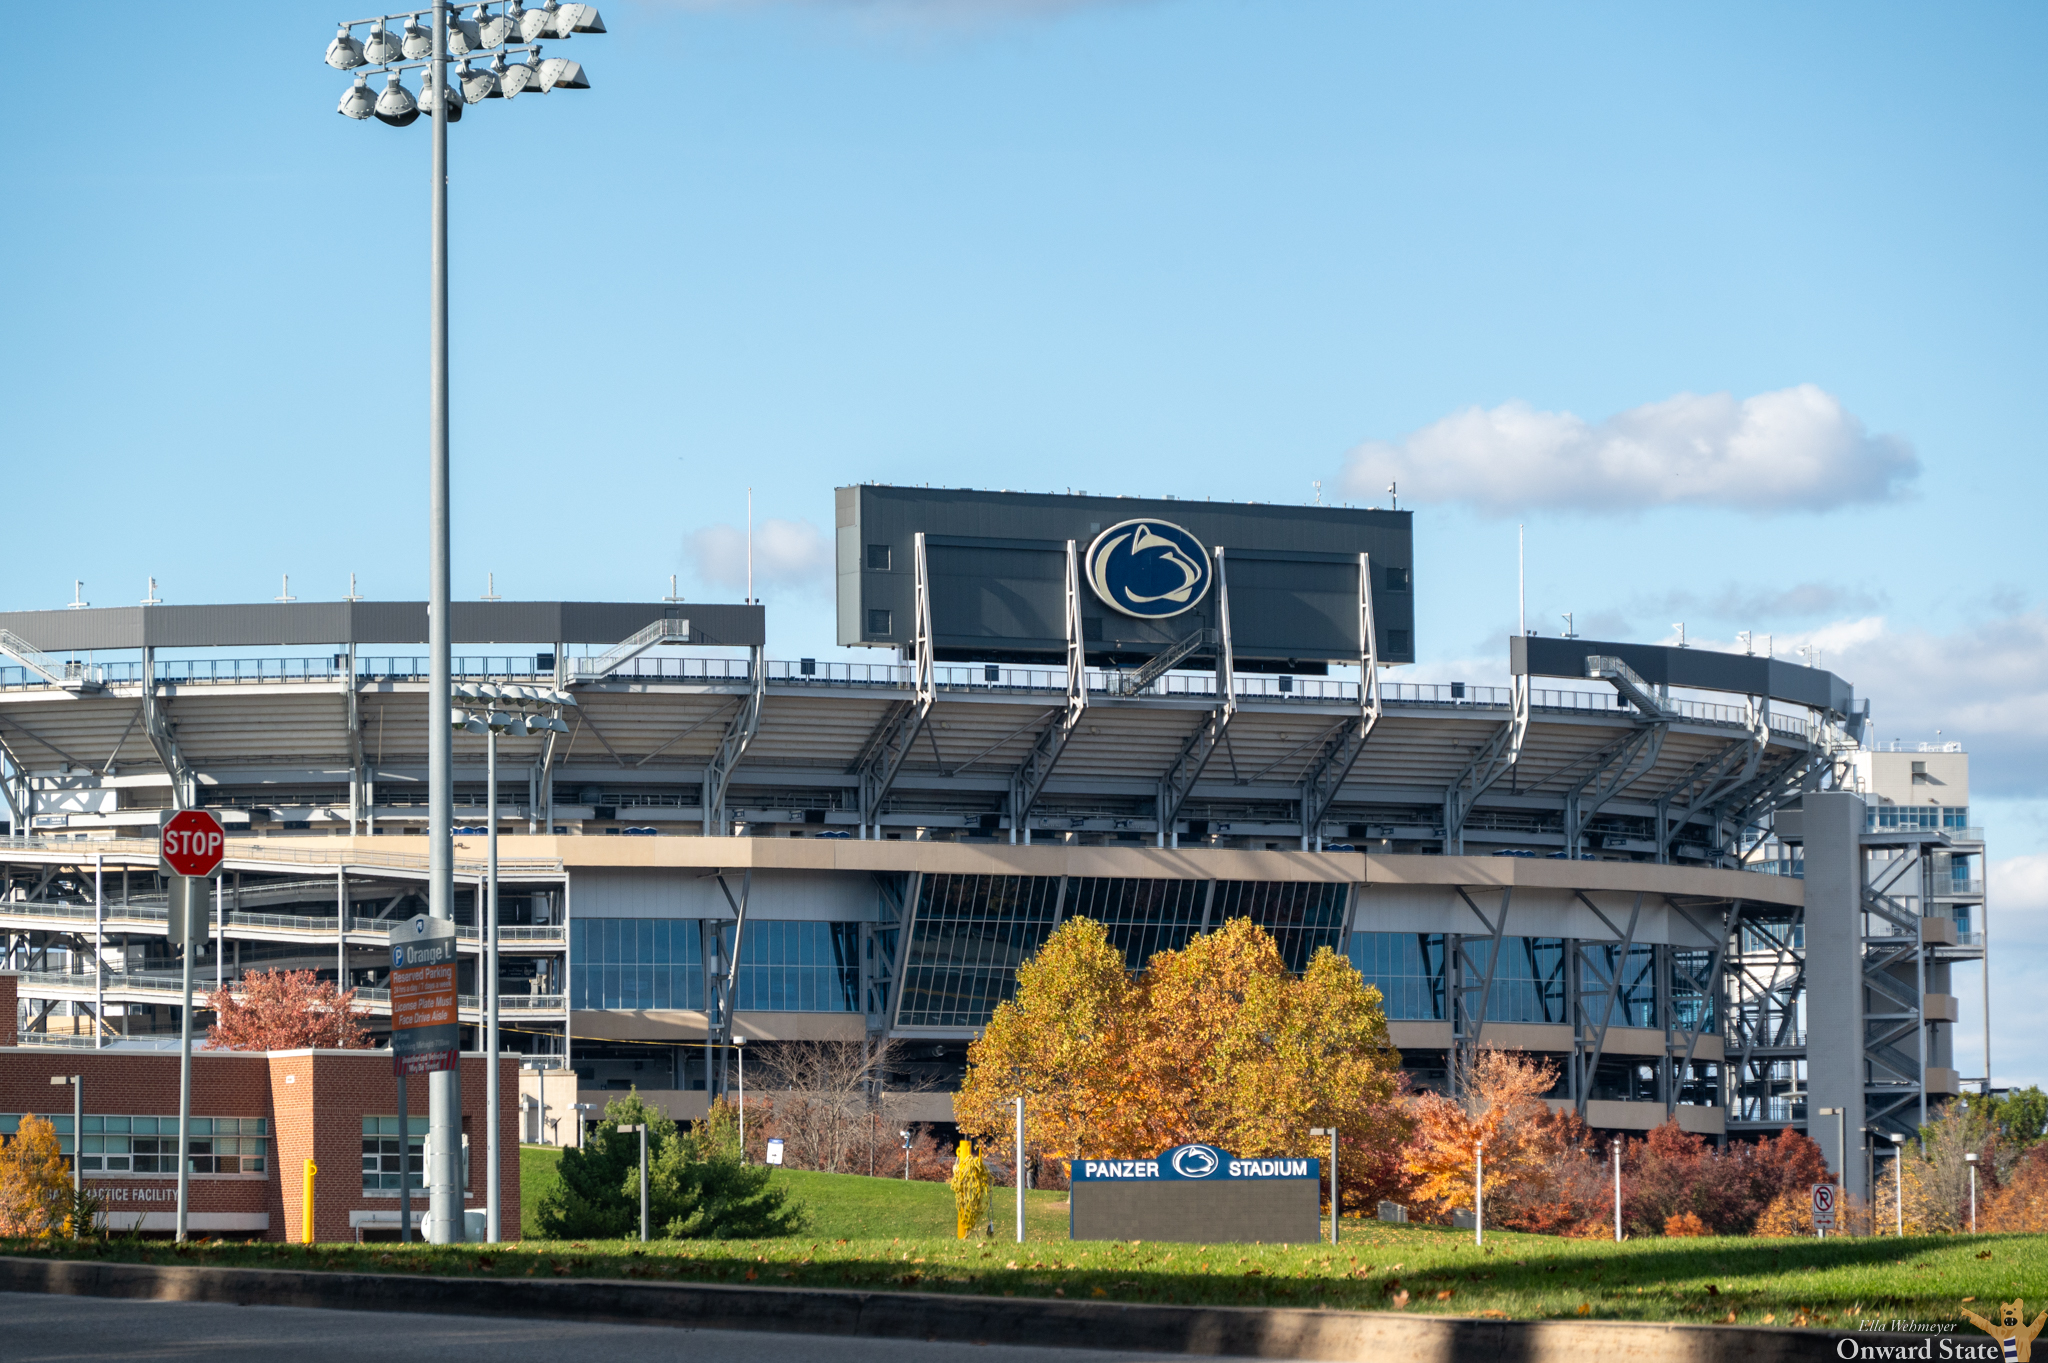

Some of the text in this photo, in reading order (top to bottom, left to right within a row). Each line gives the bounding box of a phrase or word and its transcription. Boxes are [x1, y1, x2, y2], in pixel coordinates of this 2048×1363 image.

[165, 830, 222, 856] STOP
[407, 946, 442, 965] Orange
[445, 941, 452, 959] L
[393, 966, 452, 983] Reserved Parking
[410, 984, 418, 993] day
[424, 982, 435, 991] days
[440, 980, 452, 988] week
[394, 996, 453, 1013] License Plate Must
[398, 1009, 448, 1026] Face Drive Aisle
[1085, 1160, 1308, 1178] PANZER STADIUM
[132, 1189, 179, 1202] FACILITY
